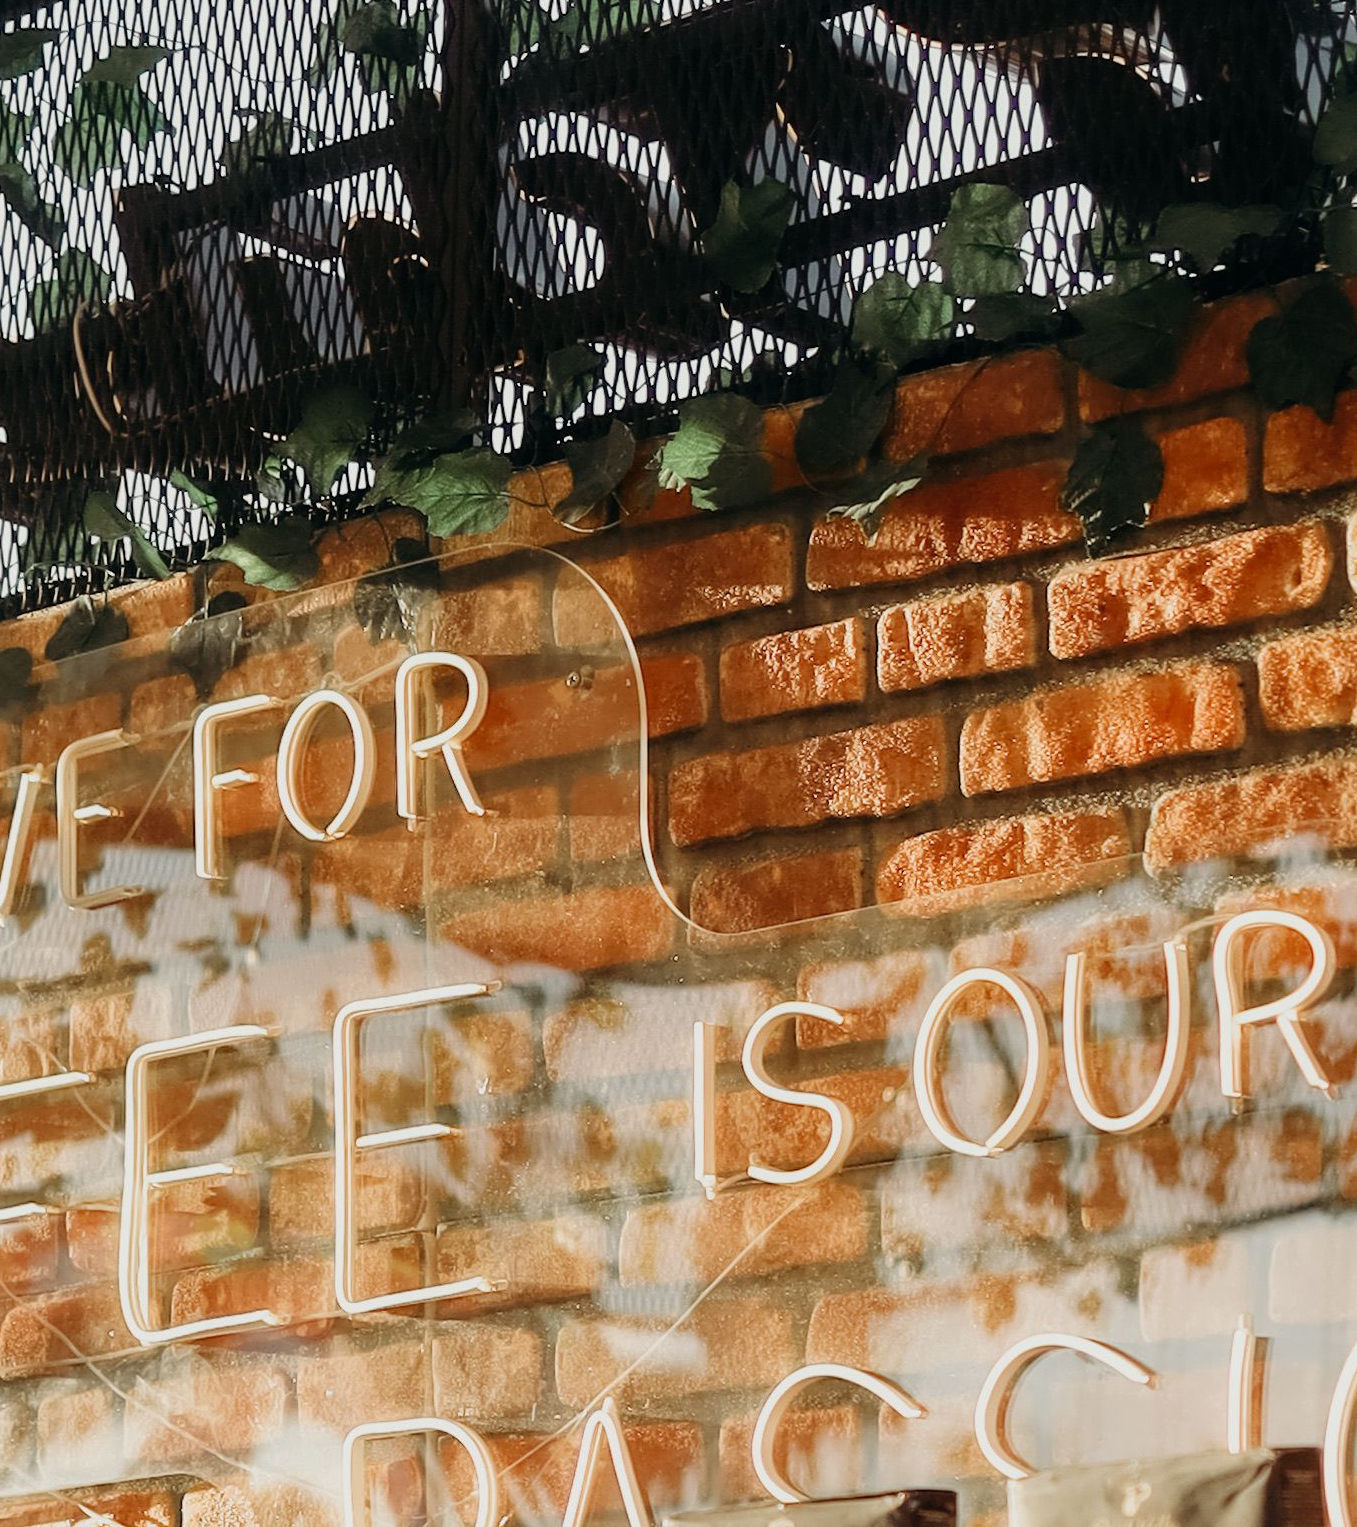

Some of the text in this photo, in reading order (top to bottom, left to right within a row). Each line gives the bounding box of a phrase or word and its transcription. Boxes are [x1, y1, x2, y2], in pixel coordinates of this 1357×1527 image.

[192, 651, 497, 881] FOR
[690, 999, 855, 1200] IS
[912, 908, 1339, 1161] OUR
